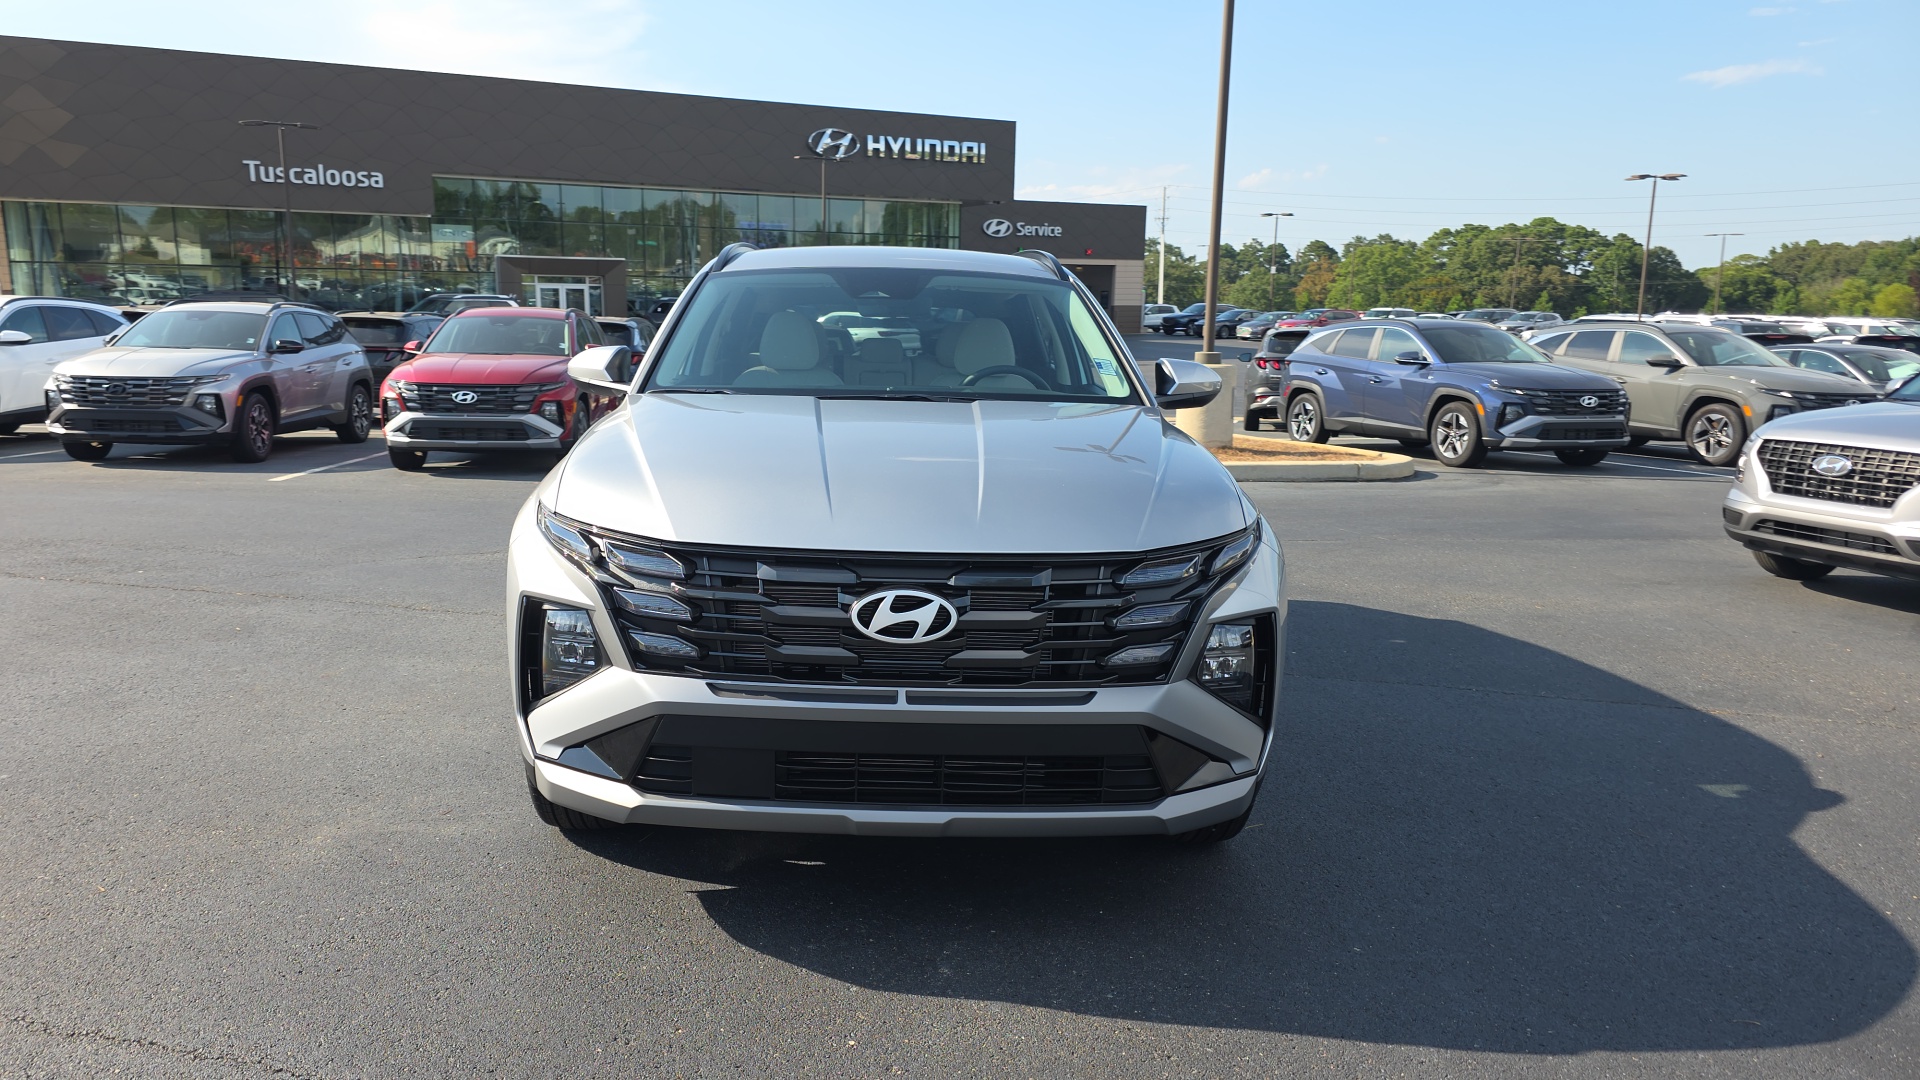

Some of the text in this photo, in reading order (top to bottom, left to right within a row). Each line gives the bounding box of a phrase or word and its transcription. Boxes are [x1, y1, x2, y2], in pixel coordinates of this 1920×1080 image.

[867, 135, 986, 164] HYUNDAI
[242, 159, 384, 188] Tuscaloosa
[1015, 222, 1063, 237] Service
